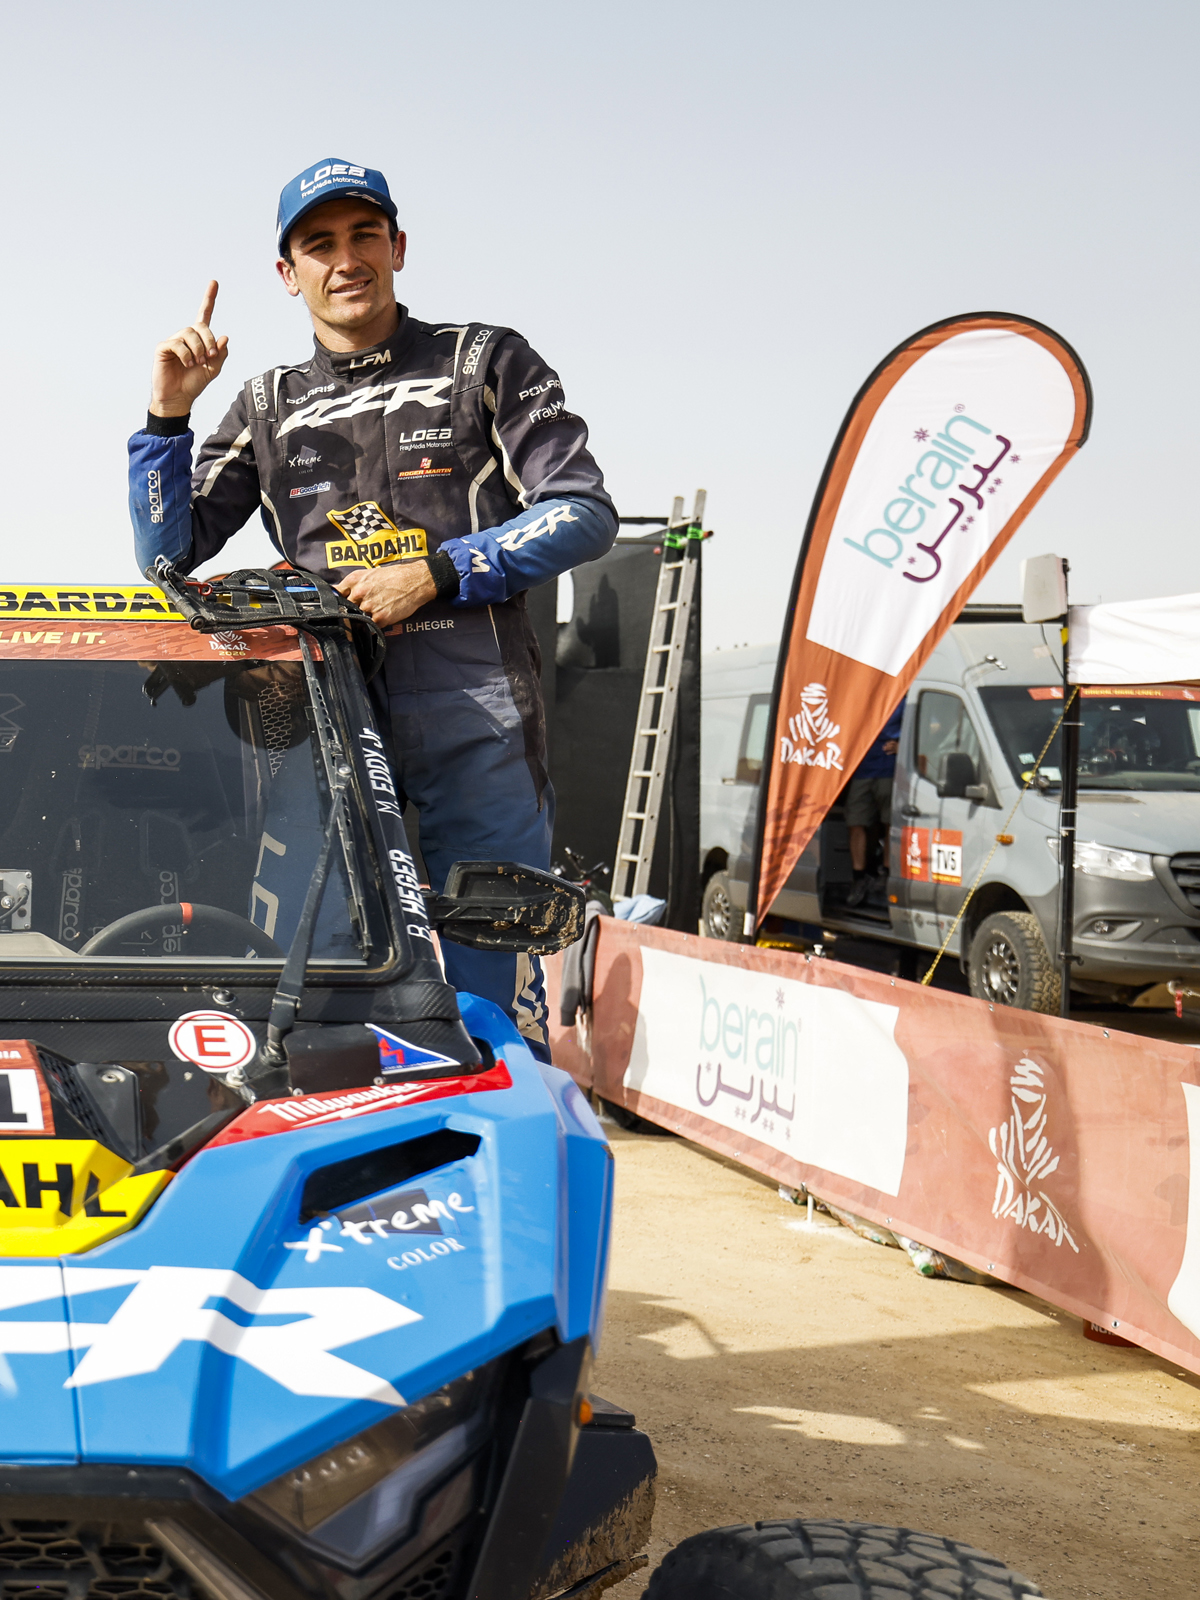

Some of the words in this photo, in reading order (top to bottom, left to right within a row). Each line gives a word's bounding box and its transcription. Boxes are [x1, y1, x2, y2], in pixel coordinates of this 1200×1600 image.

[300, 164, 366, 191] LOEB
[333, 176, 368, 187] Motorsport
[349, 349, 392, 370] LFM
[462, 329, 494, 376] sparco
[518, 379, 563, 401] POLAR
[275, 376, 455, 439] RZR
[399, 428, 453, 443] LOEB
[426, 441, 453, 449] Motorsport
[147, 470, 163, 524] sparco
[843, 414, 993, 570] berain
[495, 504, 580, 552] RZR
[330, 534, 423, 562] BARDAHL
[69, 632, 108, 645] IT.
[405, 620, 455, 633] B.HEGER
[209, 641, 251, 651] DAKAR
[358, 727, 384, 749] Jr
[779, 735, 844, 772] DAKAR
[77, 743, 182, 772] sparco
[362, 747, 395, 793] EDDY
[388, 849, 428, 921] HEGER
[59, 867, 83, 942] sparco
[193, 1024, 231, 1057] E
[698, 974, 799, 1086] berain
[257, 1080, 427, 1122] Milwaukee
[989, 1159, 1080, 1254] DAKAR
[386, 1236, 466, 1271] COLOR
